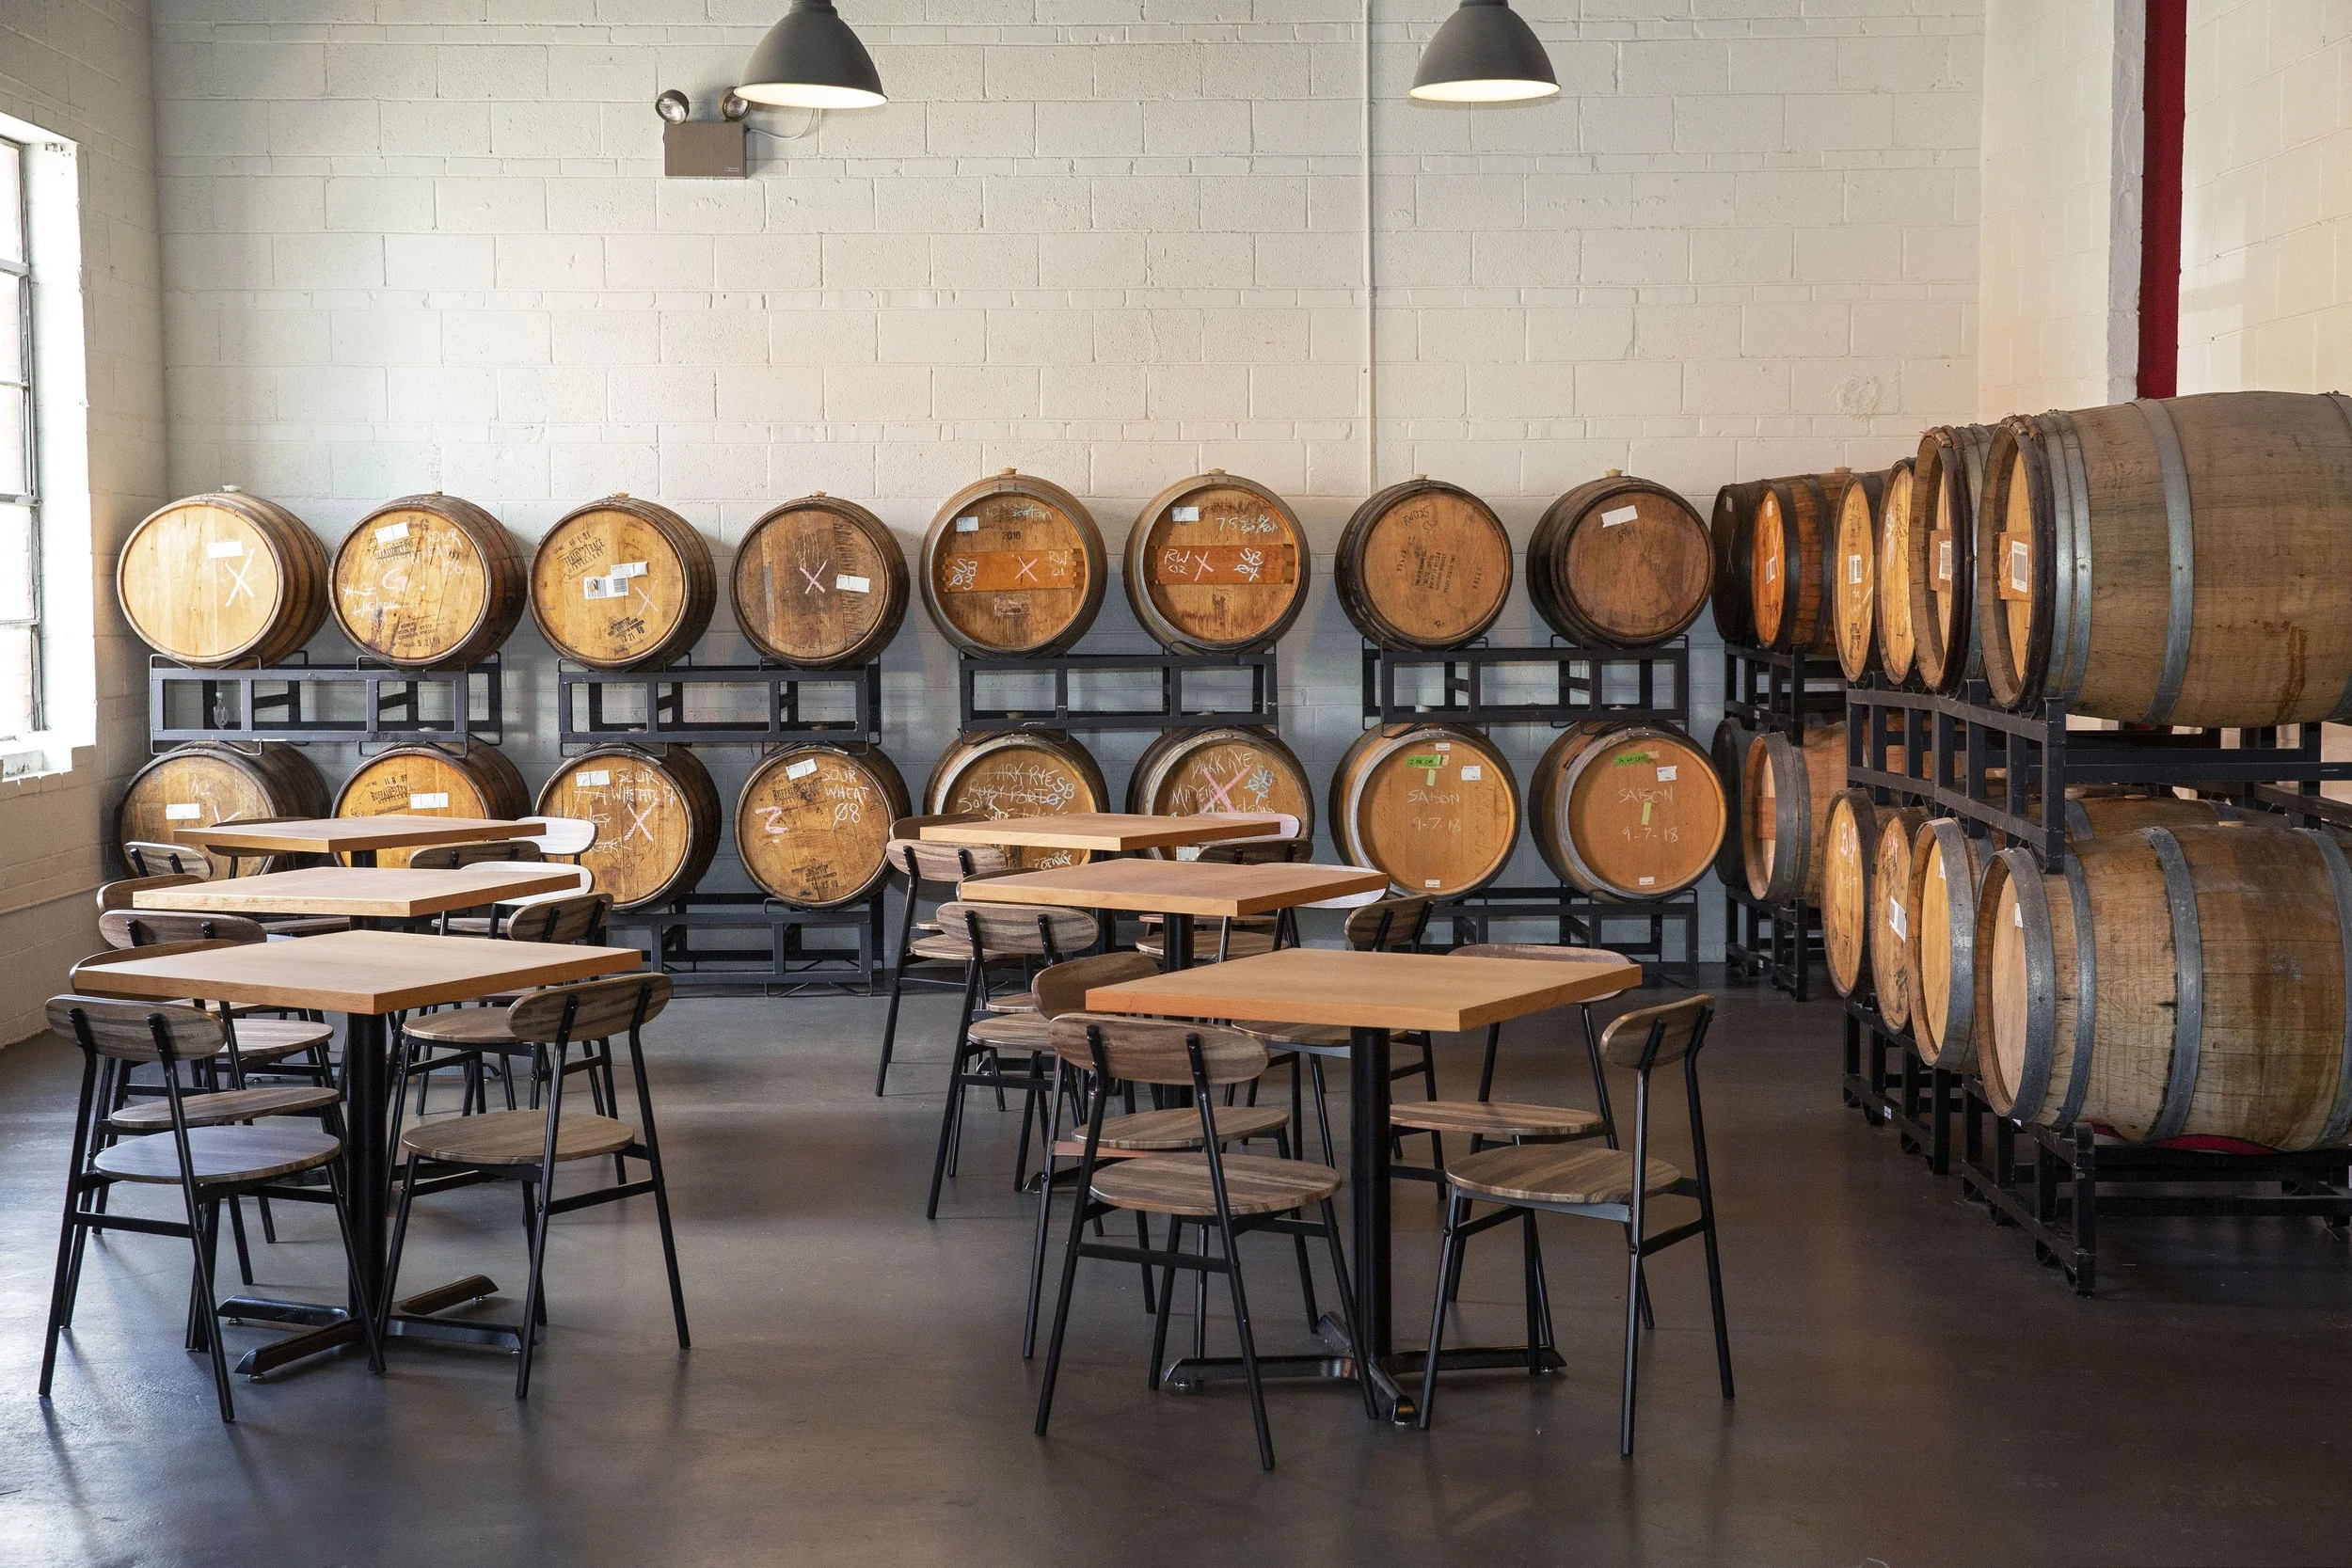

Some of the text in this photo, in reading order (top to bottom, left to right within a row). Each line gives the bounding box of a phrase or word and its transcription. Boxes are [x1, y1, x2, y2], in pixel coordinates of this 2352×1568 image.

[1002, 531, 1021, 540] 2010
[821, 767, 857, 784] SOUR
[371, 787, 393, 801] BUFFALO
[824, 784, 869, 806] WHEAT
[1407, 789, 1460, 804] SAISON
[1618, 785, 1673, 803] SAISON
